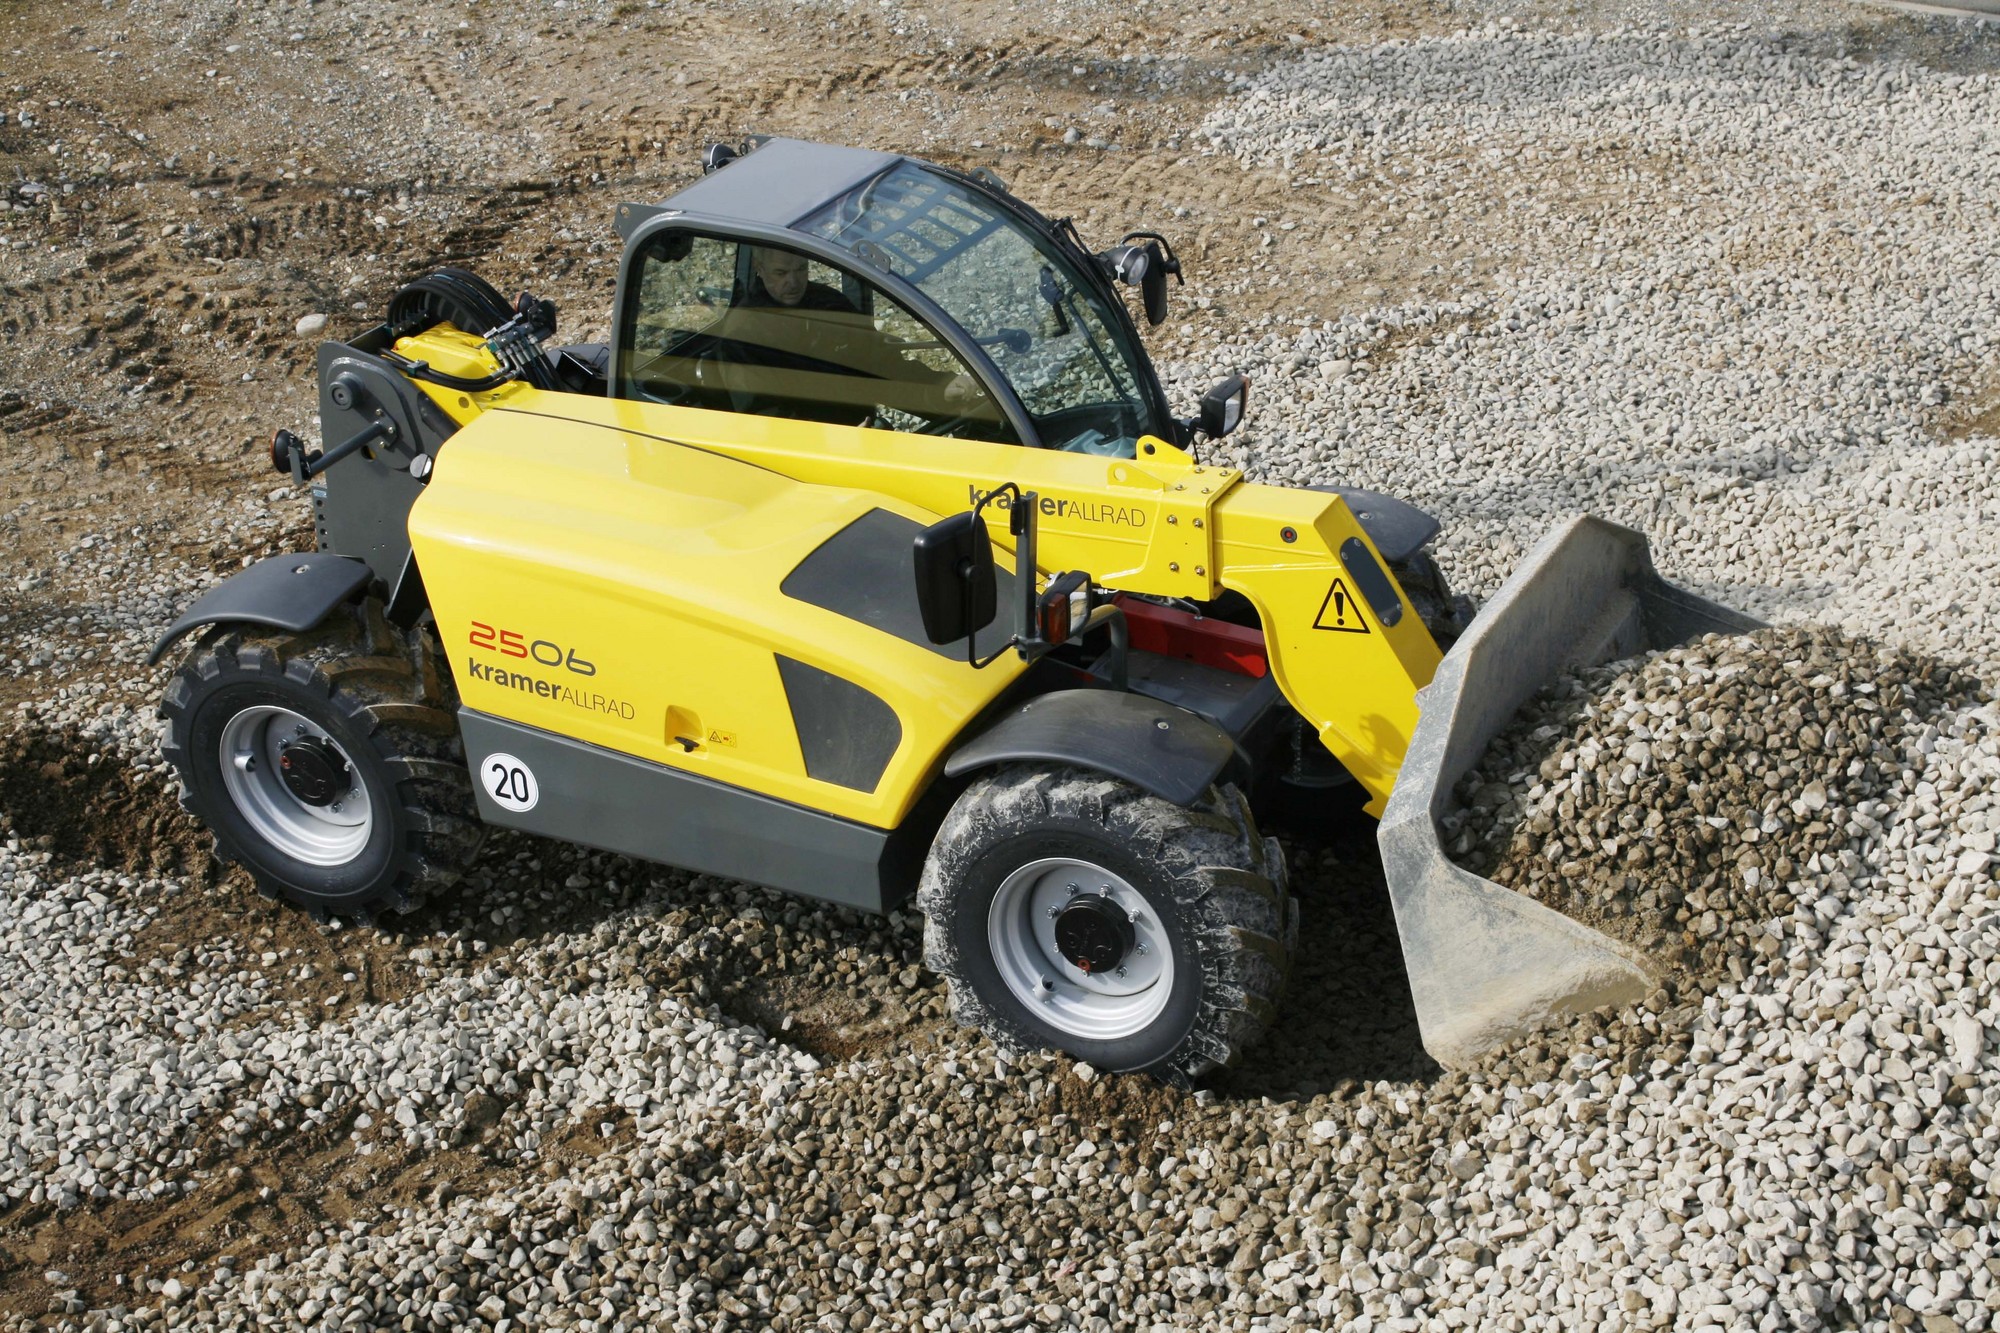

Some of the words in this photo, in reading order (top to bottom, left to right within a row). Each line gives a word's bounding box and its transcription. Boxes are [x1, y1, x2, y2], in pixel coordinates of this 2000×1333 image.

[968, 484, 1146, 527] kraerALLRAD
[469, 621, 597, 676] 2506
[491, 763, 529, 803] 20
